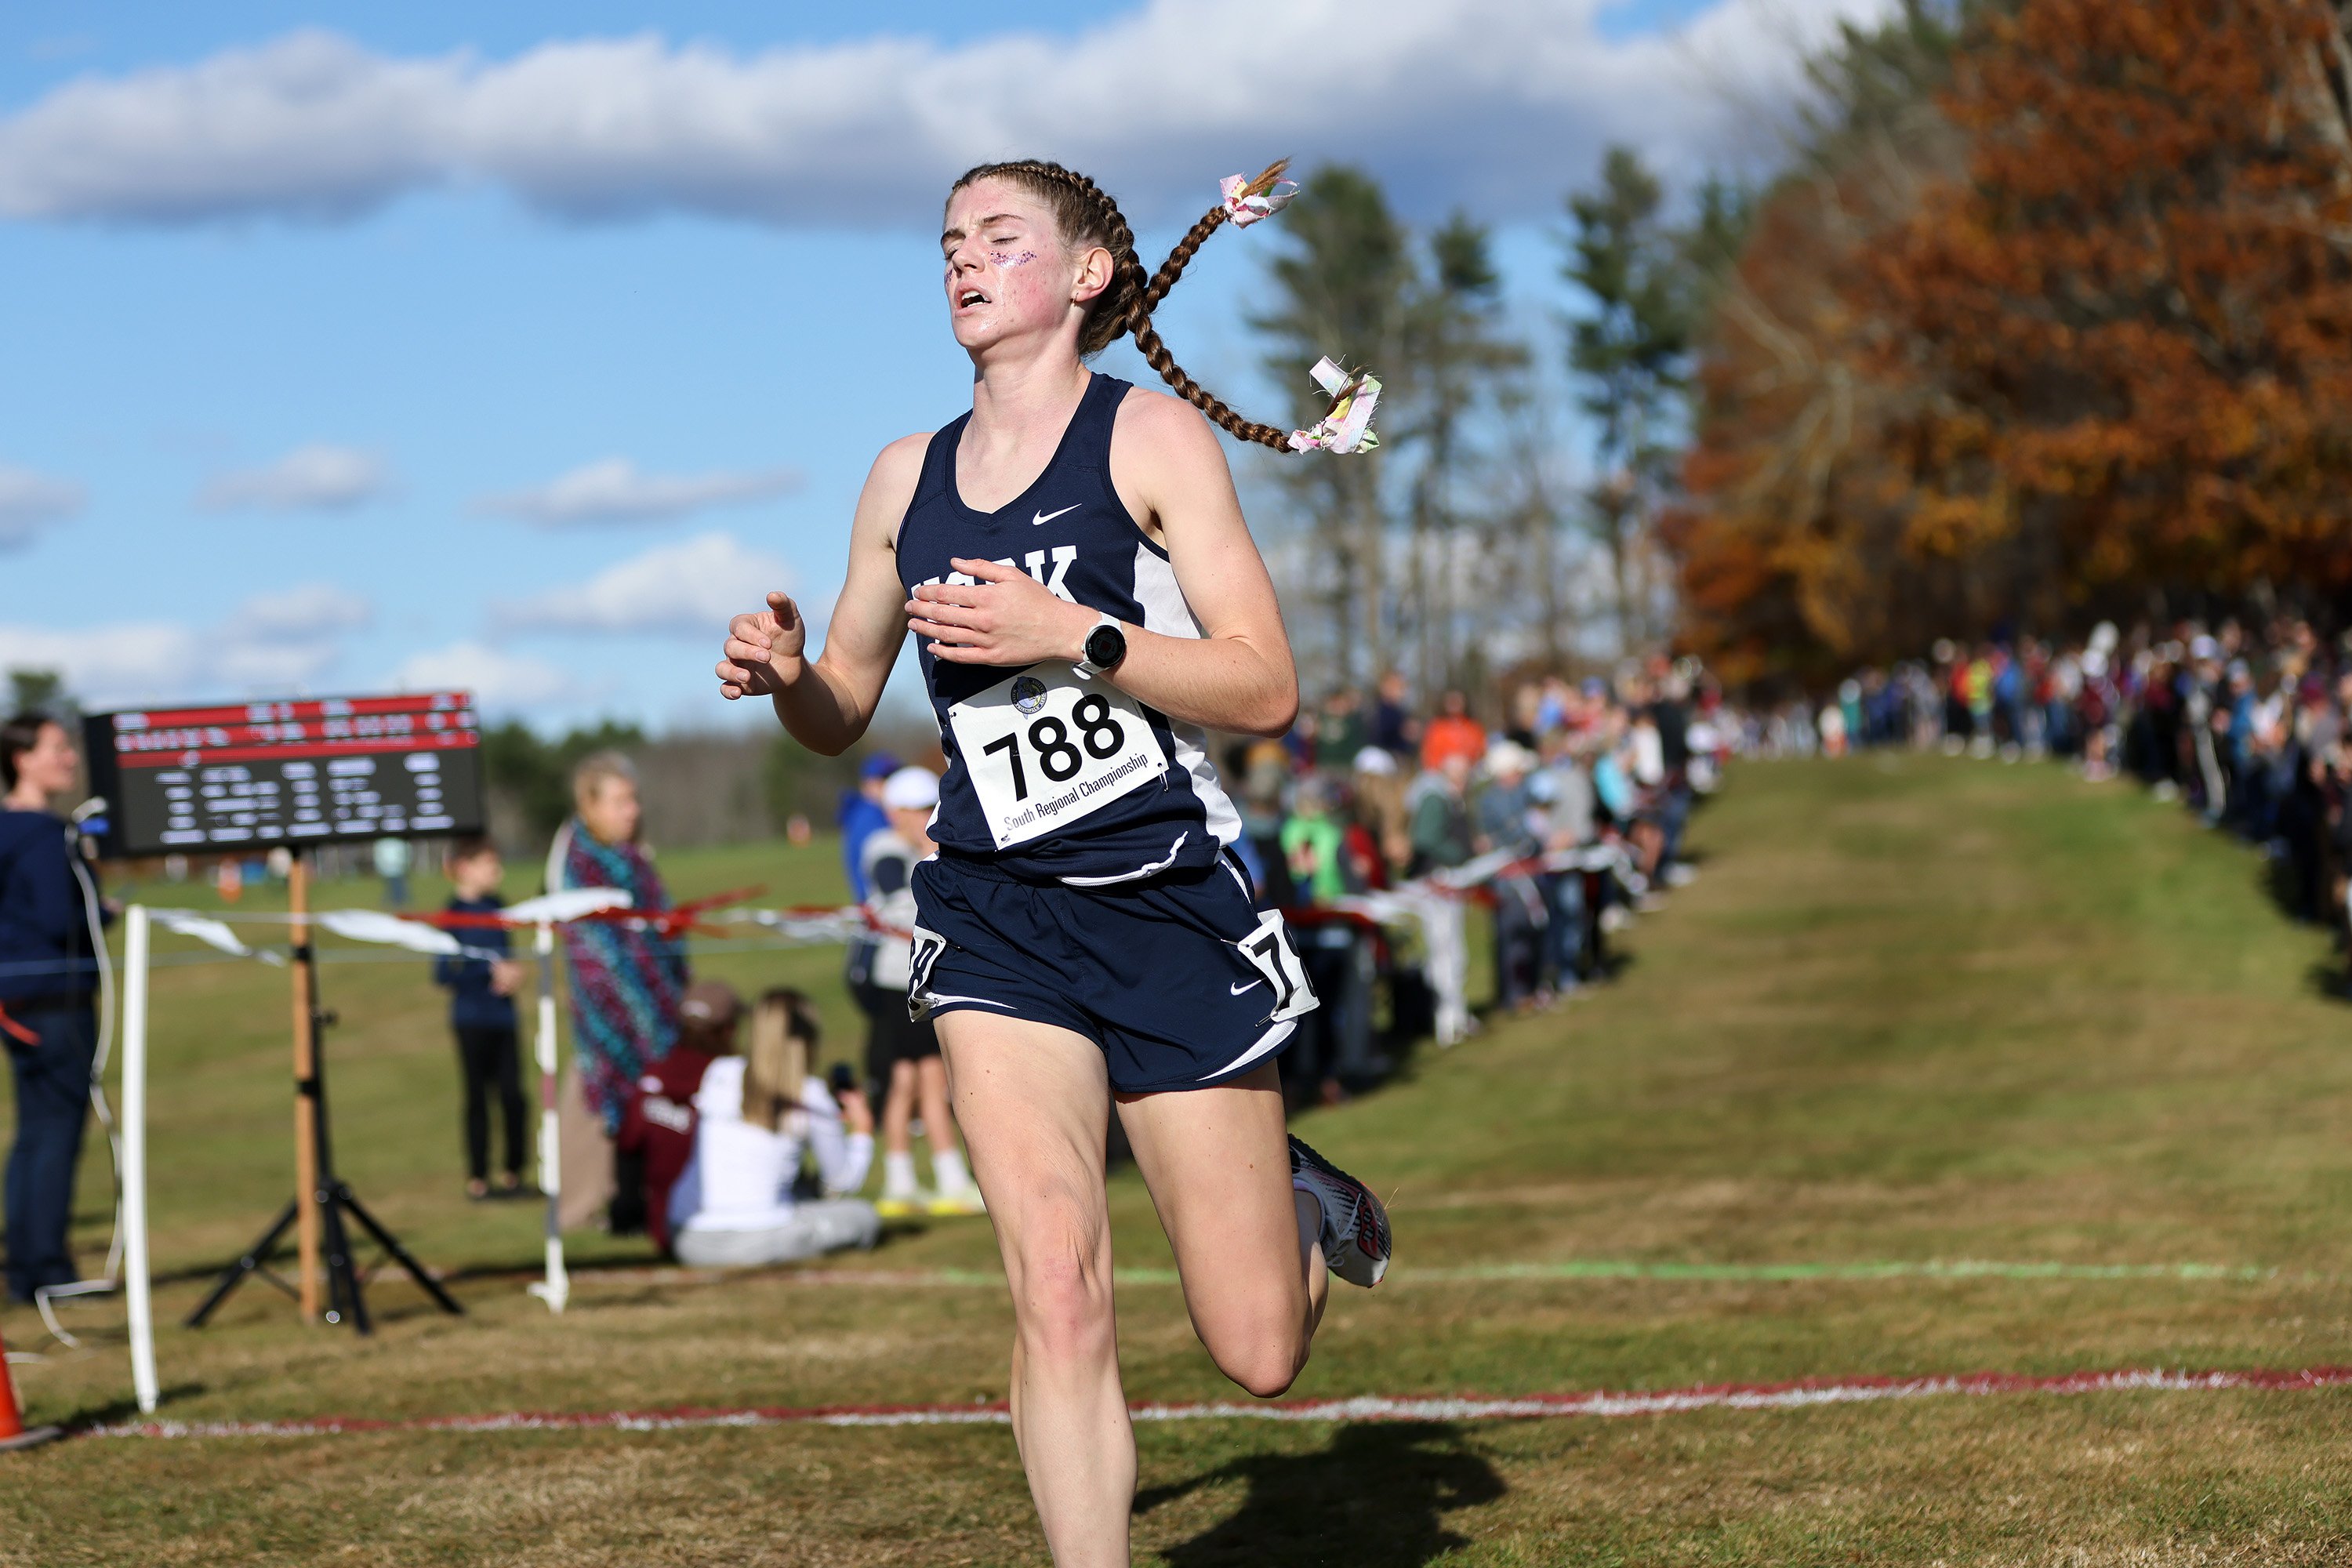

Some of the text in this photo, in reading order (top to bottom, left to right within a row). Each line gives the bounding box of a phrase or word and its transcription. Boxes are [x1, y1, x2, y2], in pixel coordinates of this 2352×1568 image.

[982, 694, 1124, 802] 788
[1004, 753, 1149, 831] South Regional Championship
[1250, 931, 1317, 1011] 7
